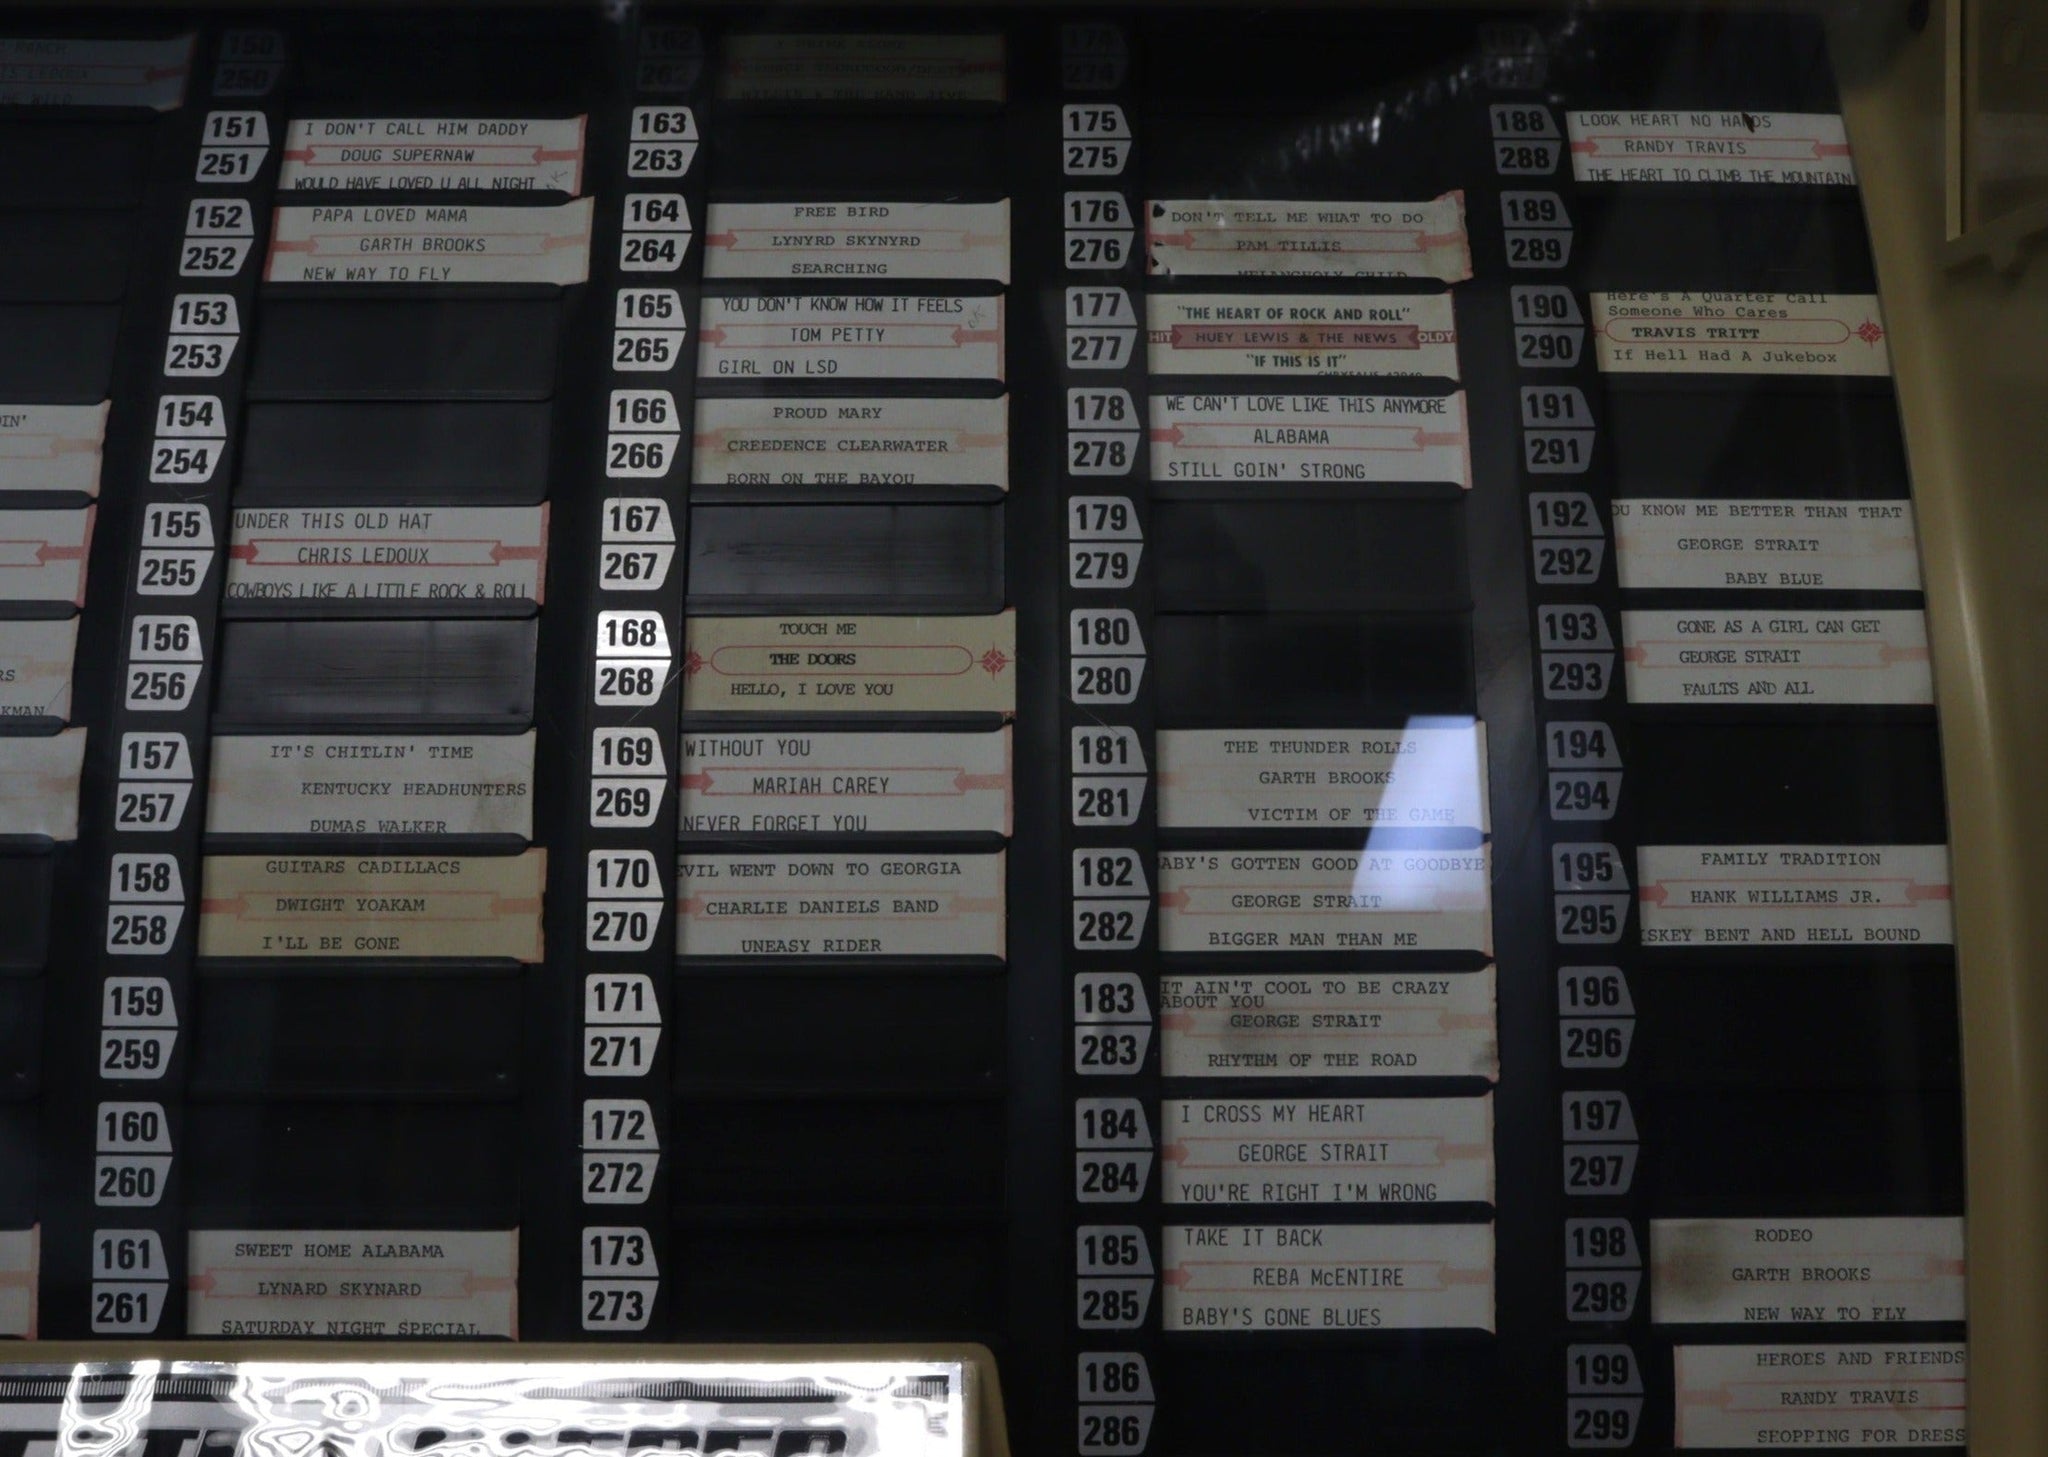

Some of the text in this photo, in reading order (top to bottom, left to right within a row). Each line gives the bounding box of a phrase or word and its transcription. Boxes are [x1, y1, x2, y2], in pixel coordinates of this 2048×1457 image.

[211, 118, 255, 137] 151
[306, 122, 528, 135] I DON'T CALL HIM DADDY
[639, 114, 686, 133] 163
[1069, 112, 1116, 130] 175
[341, 149, 474, 161] DOUG SUPERNAW
[1625, 140, 1746, 154] RANDY TRAVIS
[201, 154, 249, 175] 251
[1500, 147, 1549, 168] 288
[313, 208, 467, 222] PAPA LOVED MAMA
[795, 207, 889, 217] FREE BIRD
[360, 238, 485, 252] GARTH BROOKS
[772, 236, 920, 246] LYNYRD SKYNYRD
[184, 248, 236, 269] 252
[625, 241, 675, 261] 264
[304, 267, 450, 280] NEW WAY TO FLY
[792, 264, 887, 274] SEARCHING
[624, 296, 672, 317] 165
[790, 328, 884, 342] TOM PETTY
[1196, 332, 1396, 343] HUEY LEWIS & THE NEWS
[1632, 328, 1759, 338] TRAVIS TRITT
[1521, 336, 1572, 359] 290
[719, 360, 837, 374] GIRL ON LSD
[164, 403, 213, 426] 154
[617, 399, 666, 423] 166
[774, 408, 882, 418] PROUD MARY
[1074, 396, 1124, 420] 178
[1254, 429, 1329, 444] ALABAMA
[728, 440, 948, 452] CREEDENCE CLEARWATER
[1073, 442, 1125, 466] 278
[1169, 462, 1365, 479] STILL GOIN' STRONG
[235, 512, 432, 529] UNDER THIS OLD HAT
[1537, 502, 1587, 526] 192
[150, 512, 200, 536] 155
[1678, 538, 1819, 551] GEORGE STRAIT
[298, 548, 428, 564] CHRIS LEDOUX
[1726, 573, 1823, 585] BABY BLUE
[138, 624, 189, 650] 156
[606, 620, 656, 646] 168
[780, 623, 856, 634] TOUCH ME
[770, 654, 856, 665] THE DOORS
[600, 668, 653, 694] 268
[1549, 664, 1602, 690] 293
[272, 746, 473, 758] IT'S CHITLIN' TIME
[685, 740, 810, 756] WITHOUT YOU
[1080, 737, 1127, 764] 181
[302, 783, 526, 796] KENTUCKY HEADHUNTERS
[754, 777, 888, 794] MARIAH CAREY
[310, 820, 446, 833] DUMAS WALKER
[266, 861, 460, 874] GUITARS CADILLACS
[1560, 854, 1612, 880] 195
[1702, 853, 1880, 865] FAMILY TRADITION
[118, 863, 170, 891] 158
[276, 898, 424, 911] DWIGHT YOAKAM
[1691, 890, 1880, 903] HANK WILLIAMS JR.
[706, 900, 938, 915] CHARLIE DANIELS BAND
[112, 915, 166, 944] 258
[592, 912, 647, 940] 270
[1079, 913, 1133, 940] 282
[742, 939, 881, 952] UNEASY RIDER
[1209, 932, 1417, 946] BIGGER MAN THAN ME
[594, 984, 642, 1011] 171
[1081, 984, 1134, 1012] 183
[1231, 1015, 1381, 1027] GEORGE STRAIT
[1208, 1054, 1417, 1066] RHYTHM OF THE ROAD
[1183, 1105, 1364, 1122] I CROSS MY HEART
[105, 1113, 158, 1141] 160
[1239, 1144, 1388, 1162] GEORGE STRAIT
[1570, 1157, 1622, 1185] 297
[1185, 1228, 1322, 1246] TAKE IT BACK
[1755, 1229, 1812, 1242] RODEO
[236, 1244, 444, 1258] SWEET HOME ALABAMA
[1085, 1236, 1137, 1264] 185
[1254, 1268, 1403, 1286] REBA McENTIRE
[1732, 1268, 1870, 1281] GARTH BROOKS
[258, 1282, 421, 1296] LYNARD SKYNARD
[96, 1294, 148, 1321] 261
[588, 1292, 642, 1321] 273
[1184, 1308, 1380, 1326] BABY'S GONE BLUES
[1781, 1390, 1918, 1404] RANDY TRAVIS
[1083, 1417, 1138, 1445] 286
[1574, 1411, 1630, 1439] 299
